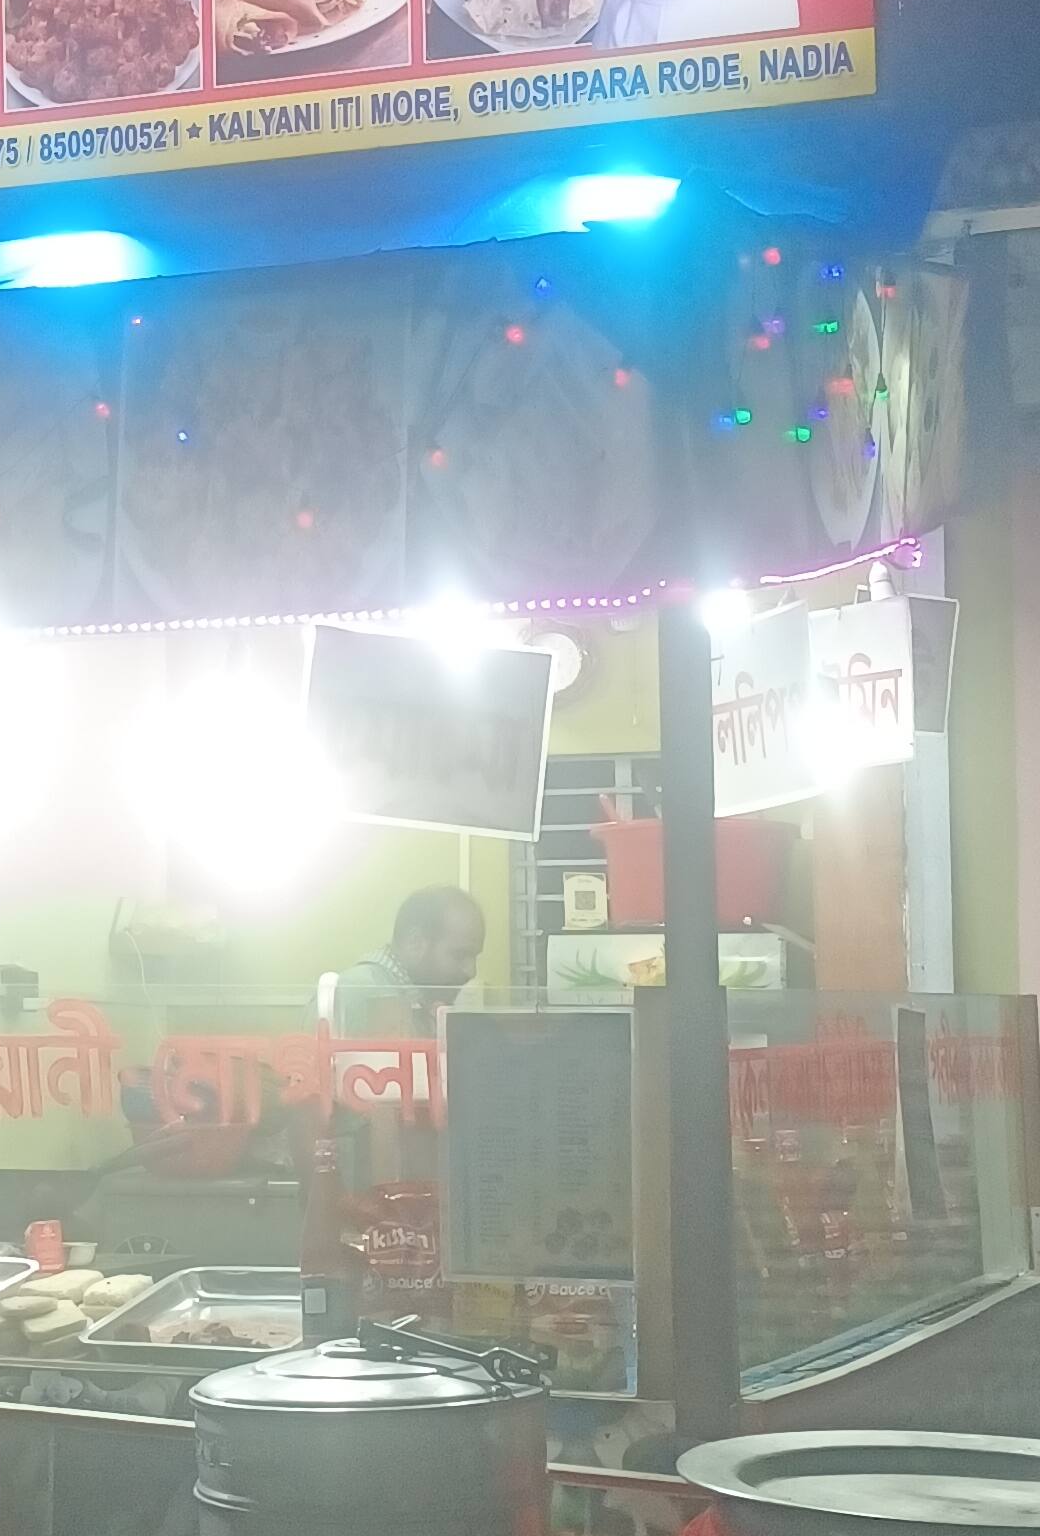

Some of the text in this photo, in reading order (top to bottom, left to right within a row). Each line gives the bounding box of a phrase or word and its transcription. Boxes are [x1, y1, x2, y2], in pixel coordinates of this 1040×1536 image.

[39, 119, 182, 163] 8509700521
[208, 102, 322, 142] KALYANI
[330, 96, 362, 131] ITI
[370, 85, 459, 125] MORE,
[467, 64, 651, 115] GHOSHPARA
[659, 52, 751, 93] RODE,
[759, 41, 855, 83] NADIA
